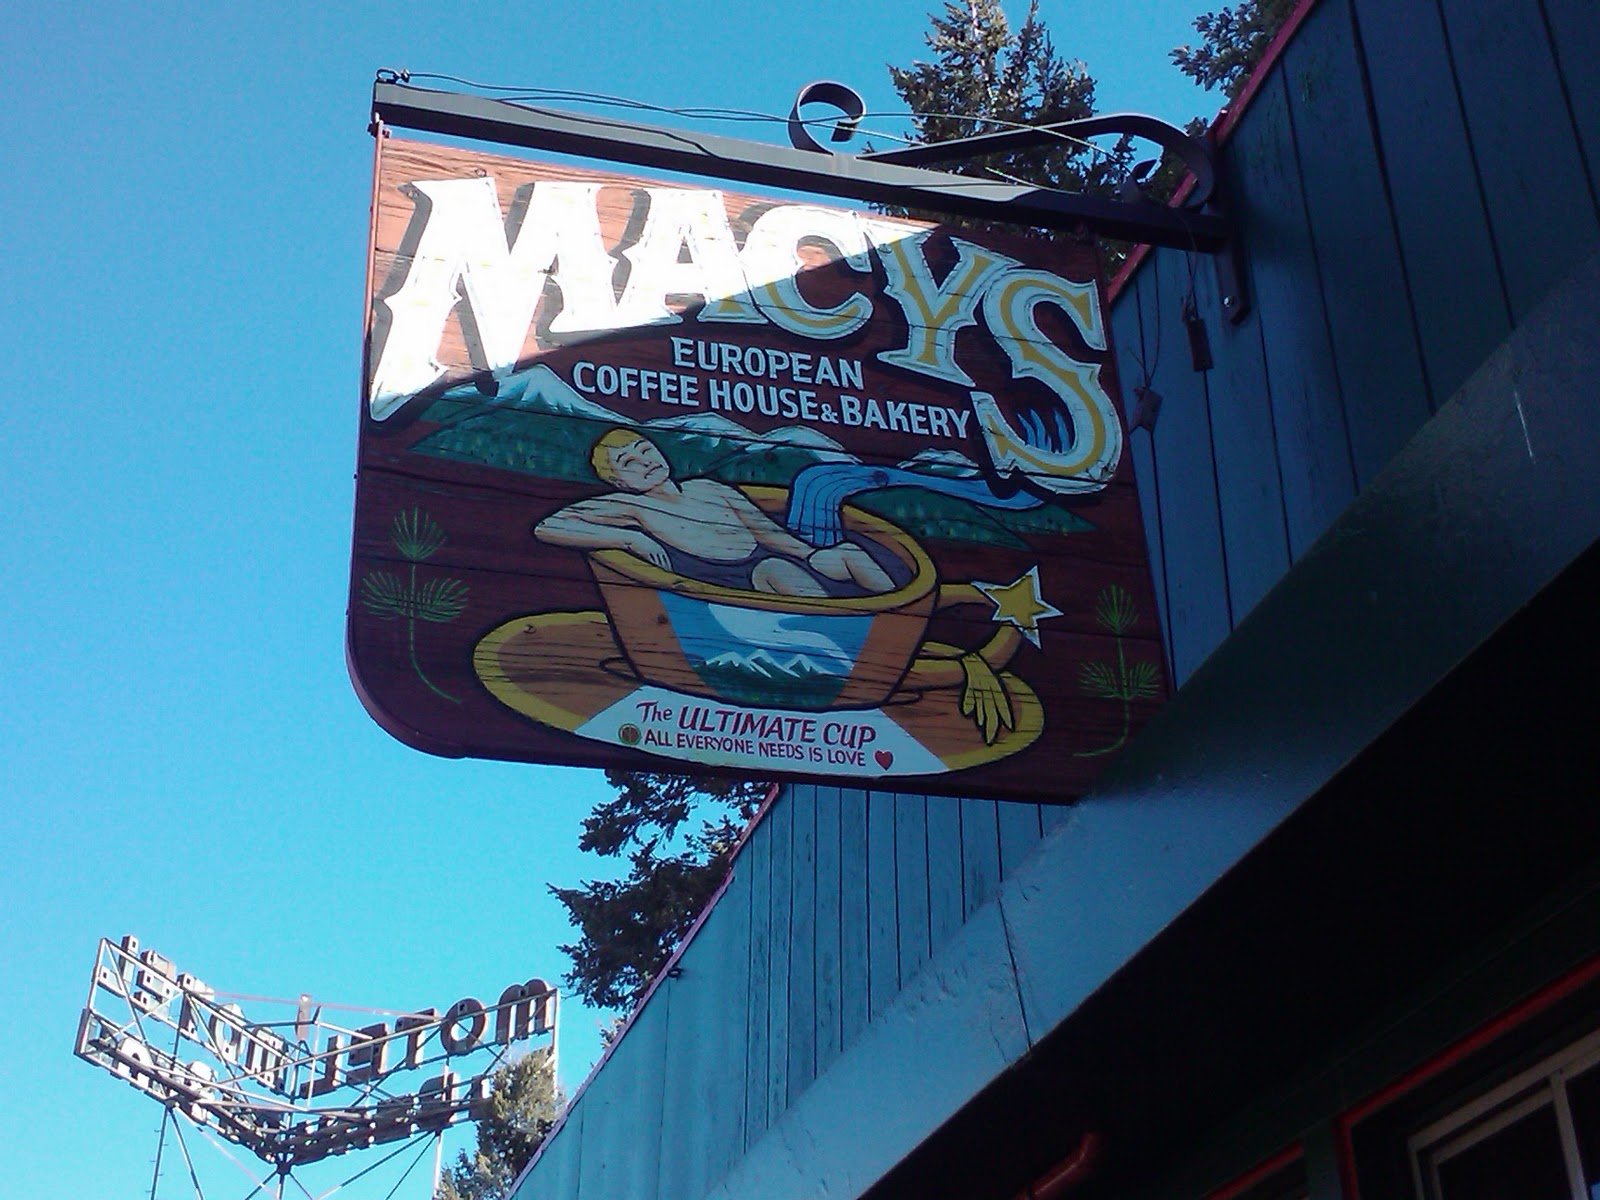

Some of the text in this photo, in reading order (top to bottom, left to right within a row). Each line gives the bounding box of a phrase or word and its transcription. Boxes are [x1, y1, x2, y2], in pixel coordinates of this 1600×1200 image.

[368, 175, 1124, 497] MACYS
[572, 361, 700, 406] COFFEE
[670, 336, 864, 390] EUROPEAN
[636, 701, 877, 750] The ULTIMATE CUP
[643, 729, 867, 767] ALL EVERYONE NEEDS IS LOVE
